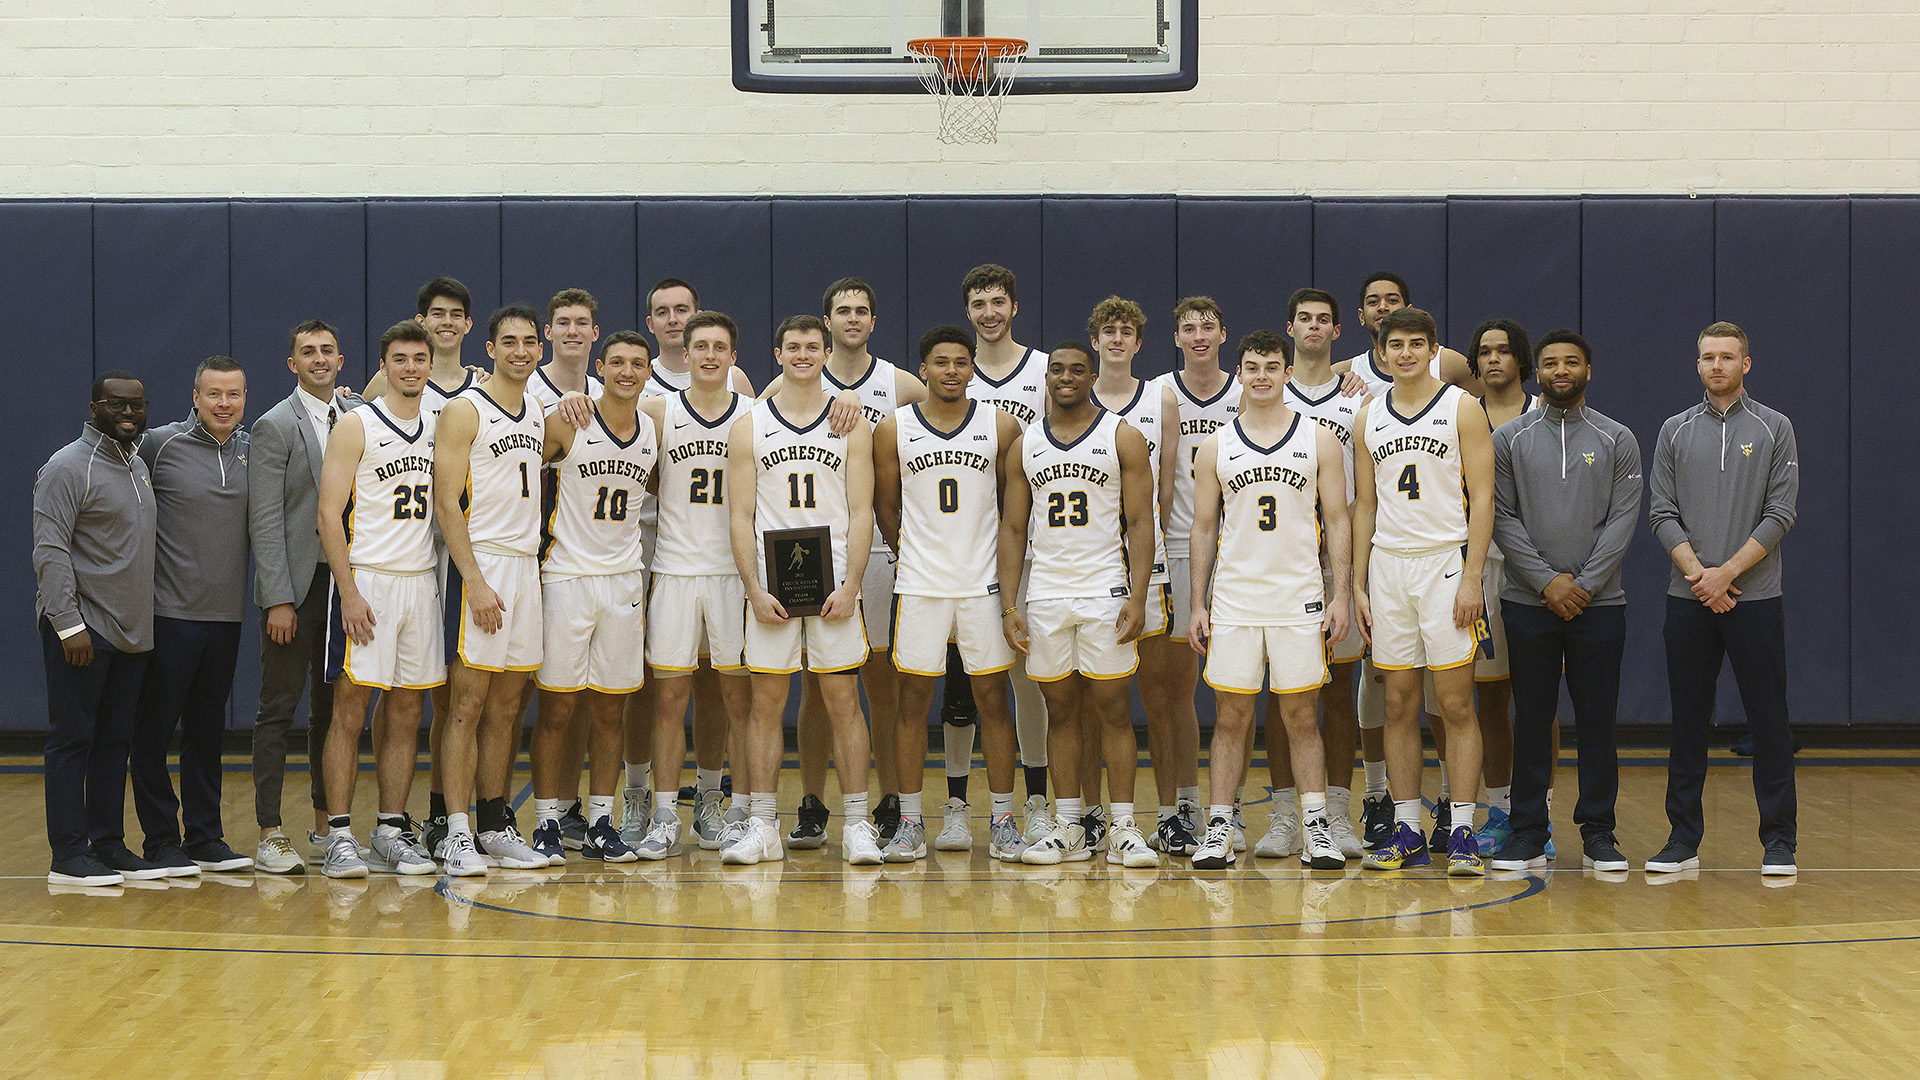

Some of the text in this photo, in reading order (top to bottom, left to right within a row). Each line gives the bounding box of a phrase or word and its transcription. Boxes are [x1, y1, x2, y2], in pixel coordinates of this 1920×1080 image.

[872, 389, 888, 398] UAA
[1139, 416, 1154, 425] UAA
[489, 433, 543, 459] ROCHESTE
[760, 445, 842, 472] ROCHESTER
[1091, 448, 1107, 456] UAA
[1292, 451, 1308, 460] UAA
[1372, 435, 1449, 466] ROCHESTER
[374, 455, 434, 482] ROCHESTE
[906, 450, 990, 476] ROCHESTER
[1030, 463, 1110, 491] ROCHESTER
[518, 461, 530, 499] 1
[689, 467, 725, 506] 21
[787, 472, 817, 510] 11
[1227, 466, 1308, 494] ROCHESTER
[1397, 463, 1421, 501] 4
[392, 484, 429, 521] 25
[592, 485, 629, 522] 10
[938, 477, 959, 514] 0
[1048, 490, 1089, 529] 23
[1257, 495, 1278, 532] 3
[1474, 618, 1490, 641] R
